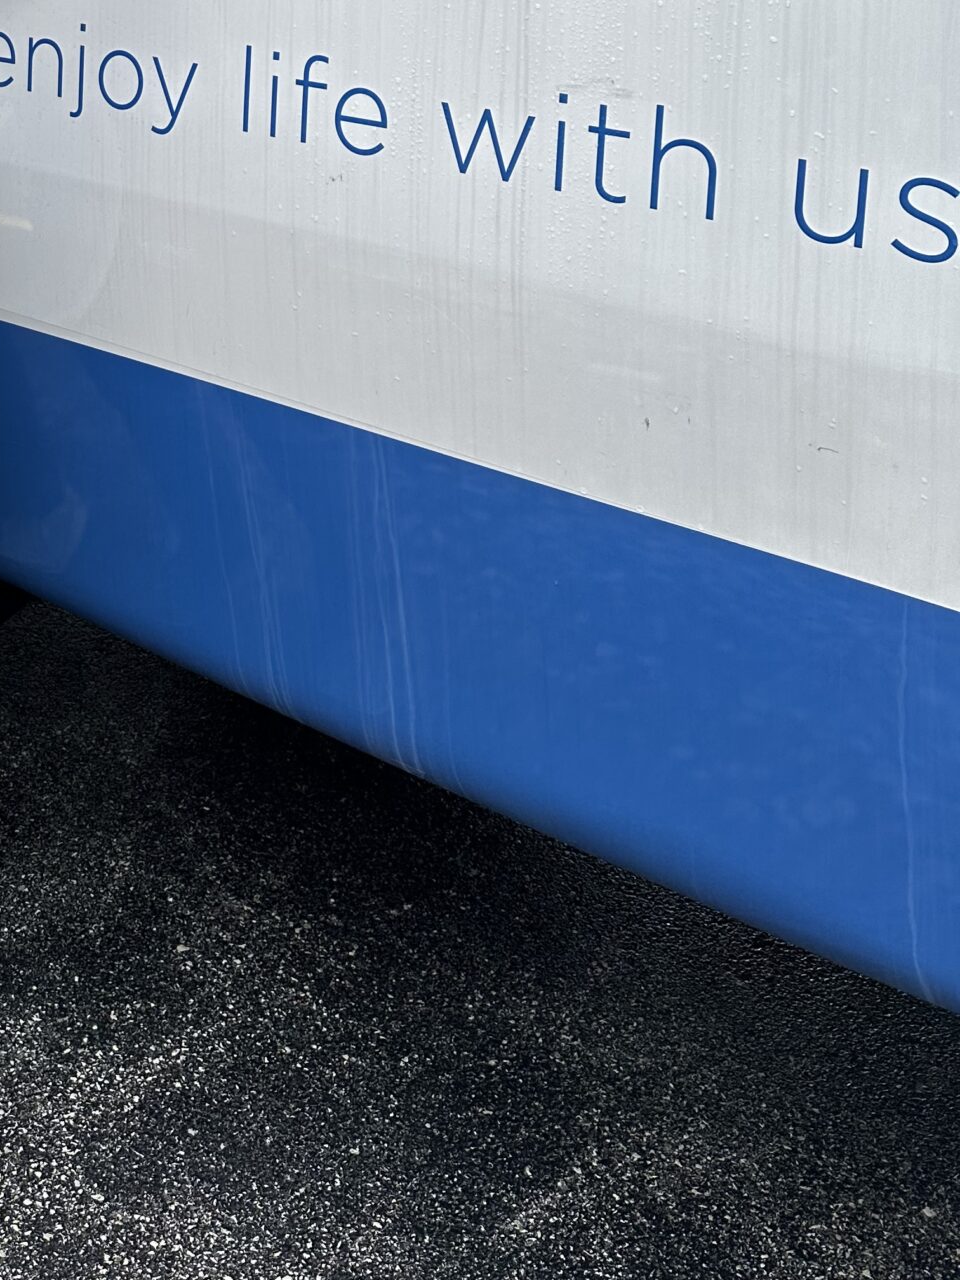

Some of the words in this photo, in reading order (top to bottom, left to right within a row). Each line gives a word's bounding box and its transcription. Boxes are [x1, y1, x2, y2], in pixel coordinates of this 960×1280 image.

[242, 46, 388, 157] life
[442, 92, 718, 221] with
[793, 159, 960, 264] us
